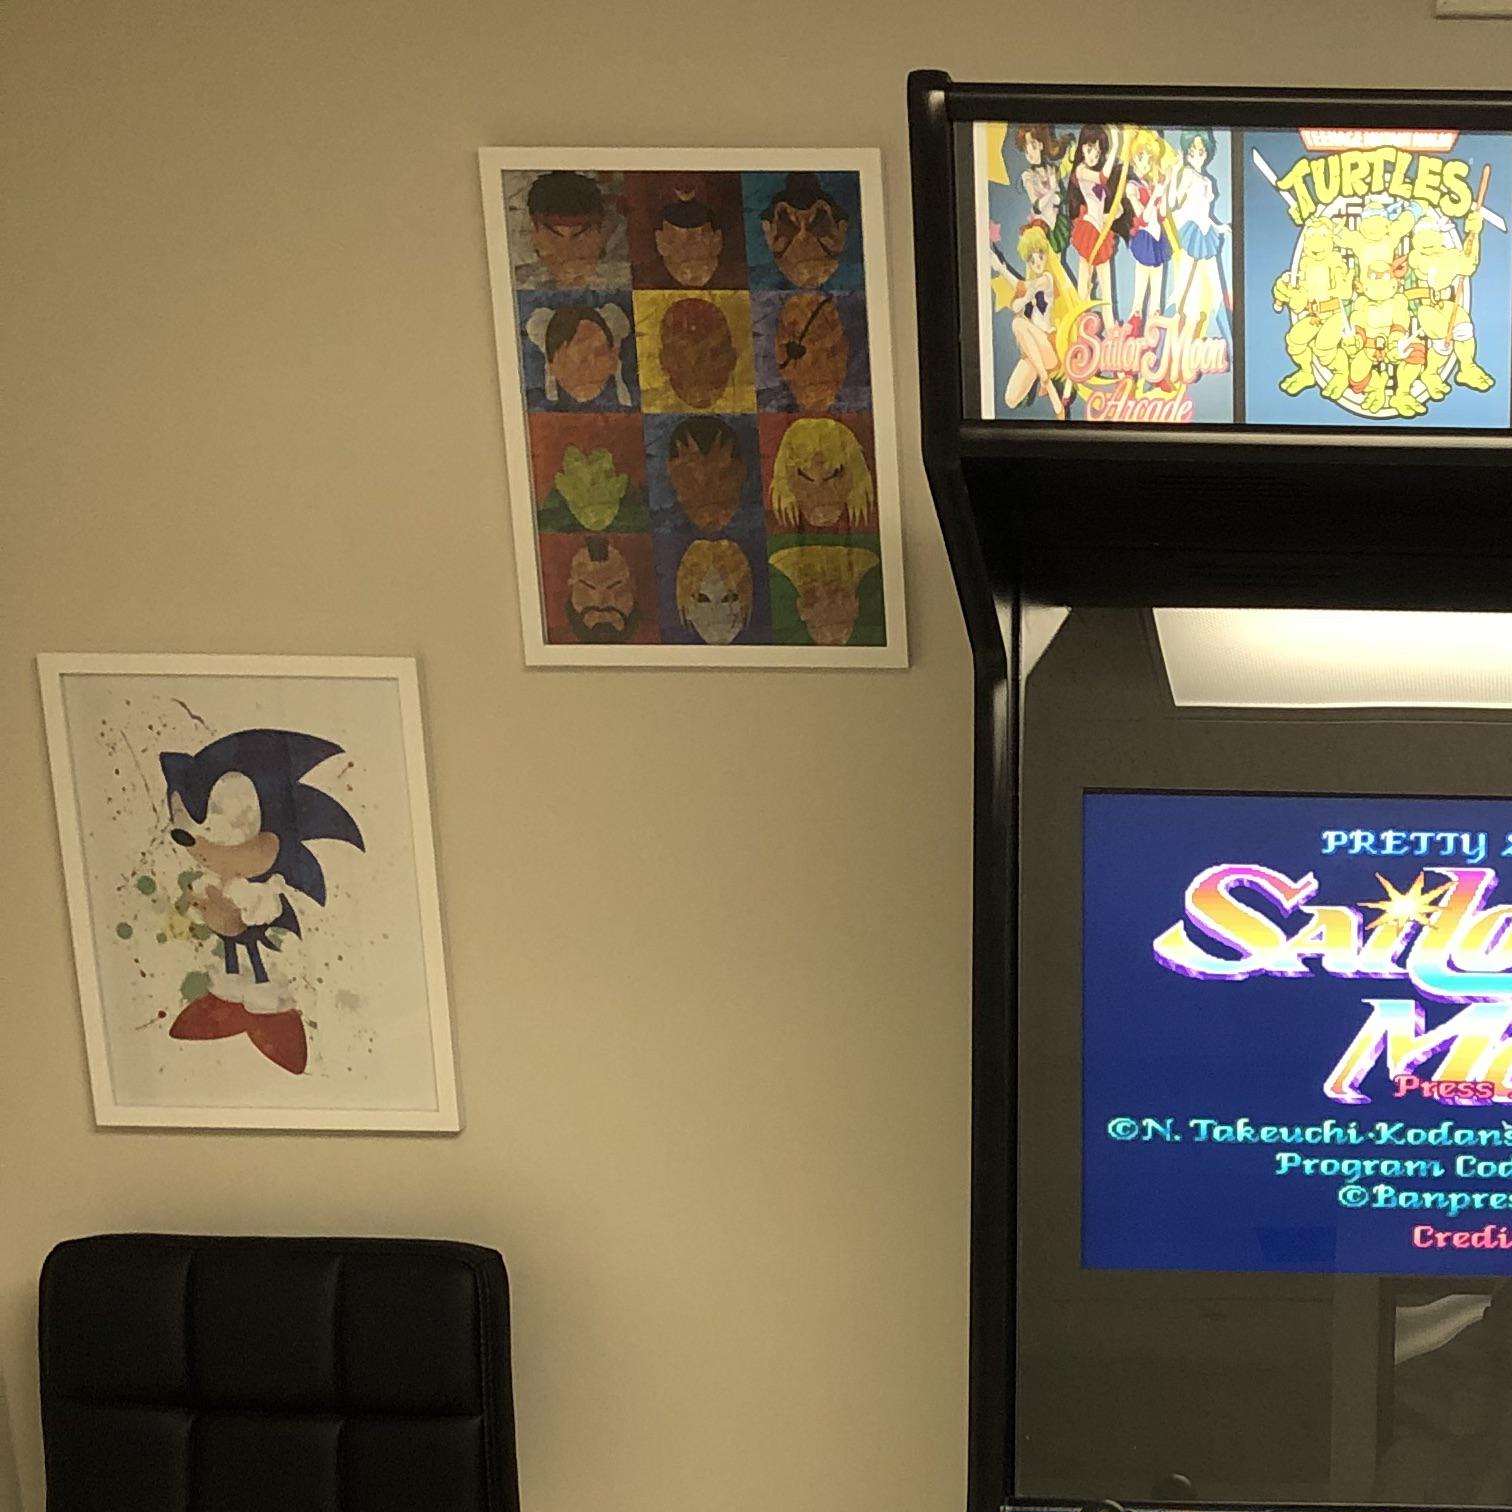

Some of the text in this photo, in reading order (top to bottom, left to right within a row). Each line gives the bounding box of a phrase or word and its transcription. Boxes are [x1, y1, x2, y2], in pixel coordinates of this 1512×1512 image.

[1276, 145, 1473, 219] TURTLES
[1065, 311, 1229, 384] Sailor Moon
[1320, 830, 1489, 864] PRETTY
[1393, 1074, 1495, 1100] Press
[1275, 1152, 1445, 1183] Program
